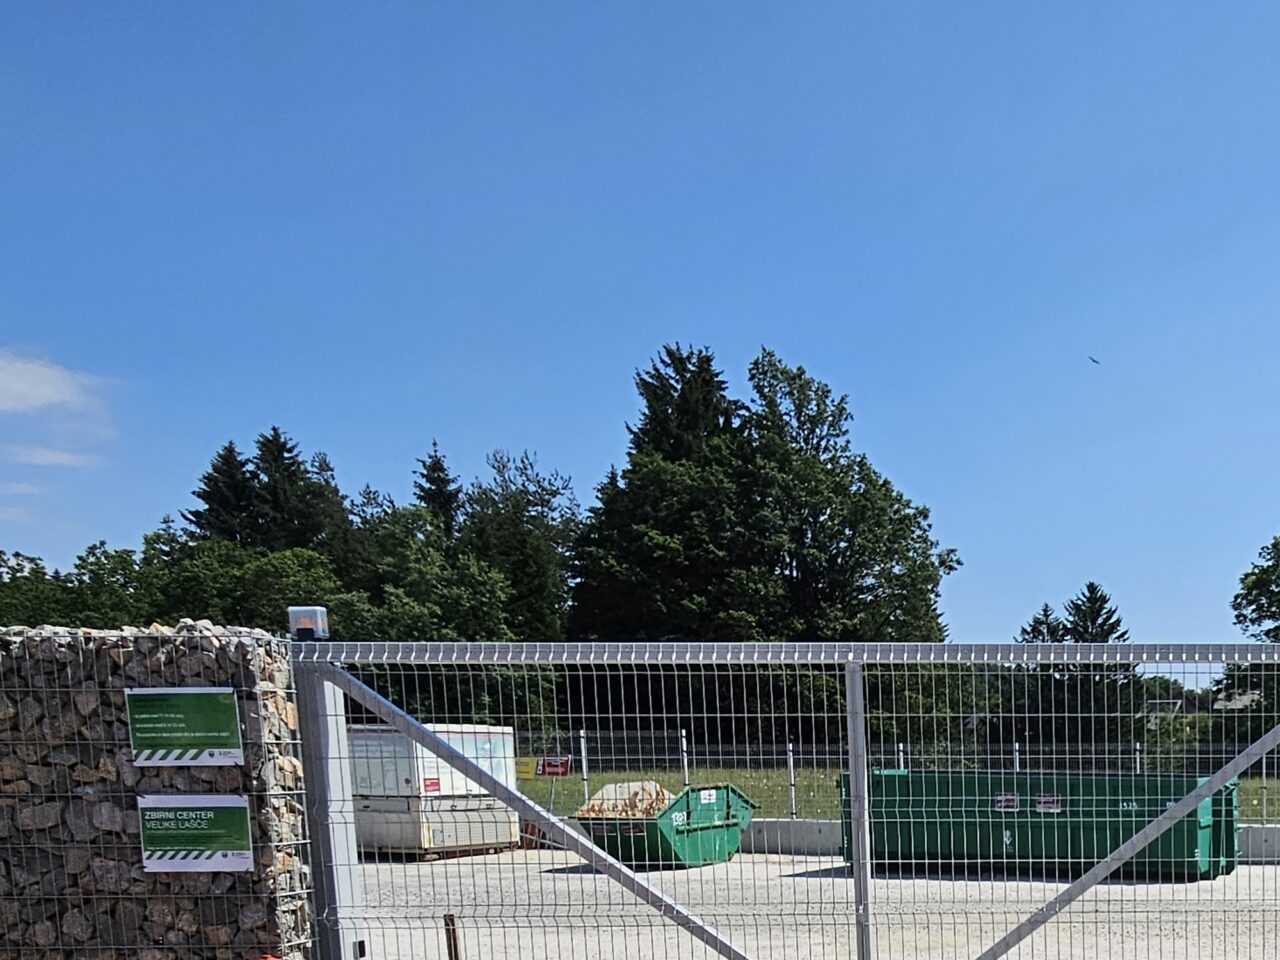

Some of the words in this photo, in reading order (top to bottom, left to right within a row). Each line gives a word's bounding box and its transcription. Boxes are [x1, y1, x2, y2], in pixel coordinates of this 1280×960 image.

[144, 811, 175, 819] ZBIRNI
[176, 811, 214, 819] CENTER
[145, 820, 177, 829] VELIKE
[178, 819, 208, 829] LAŠČE
